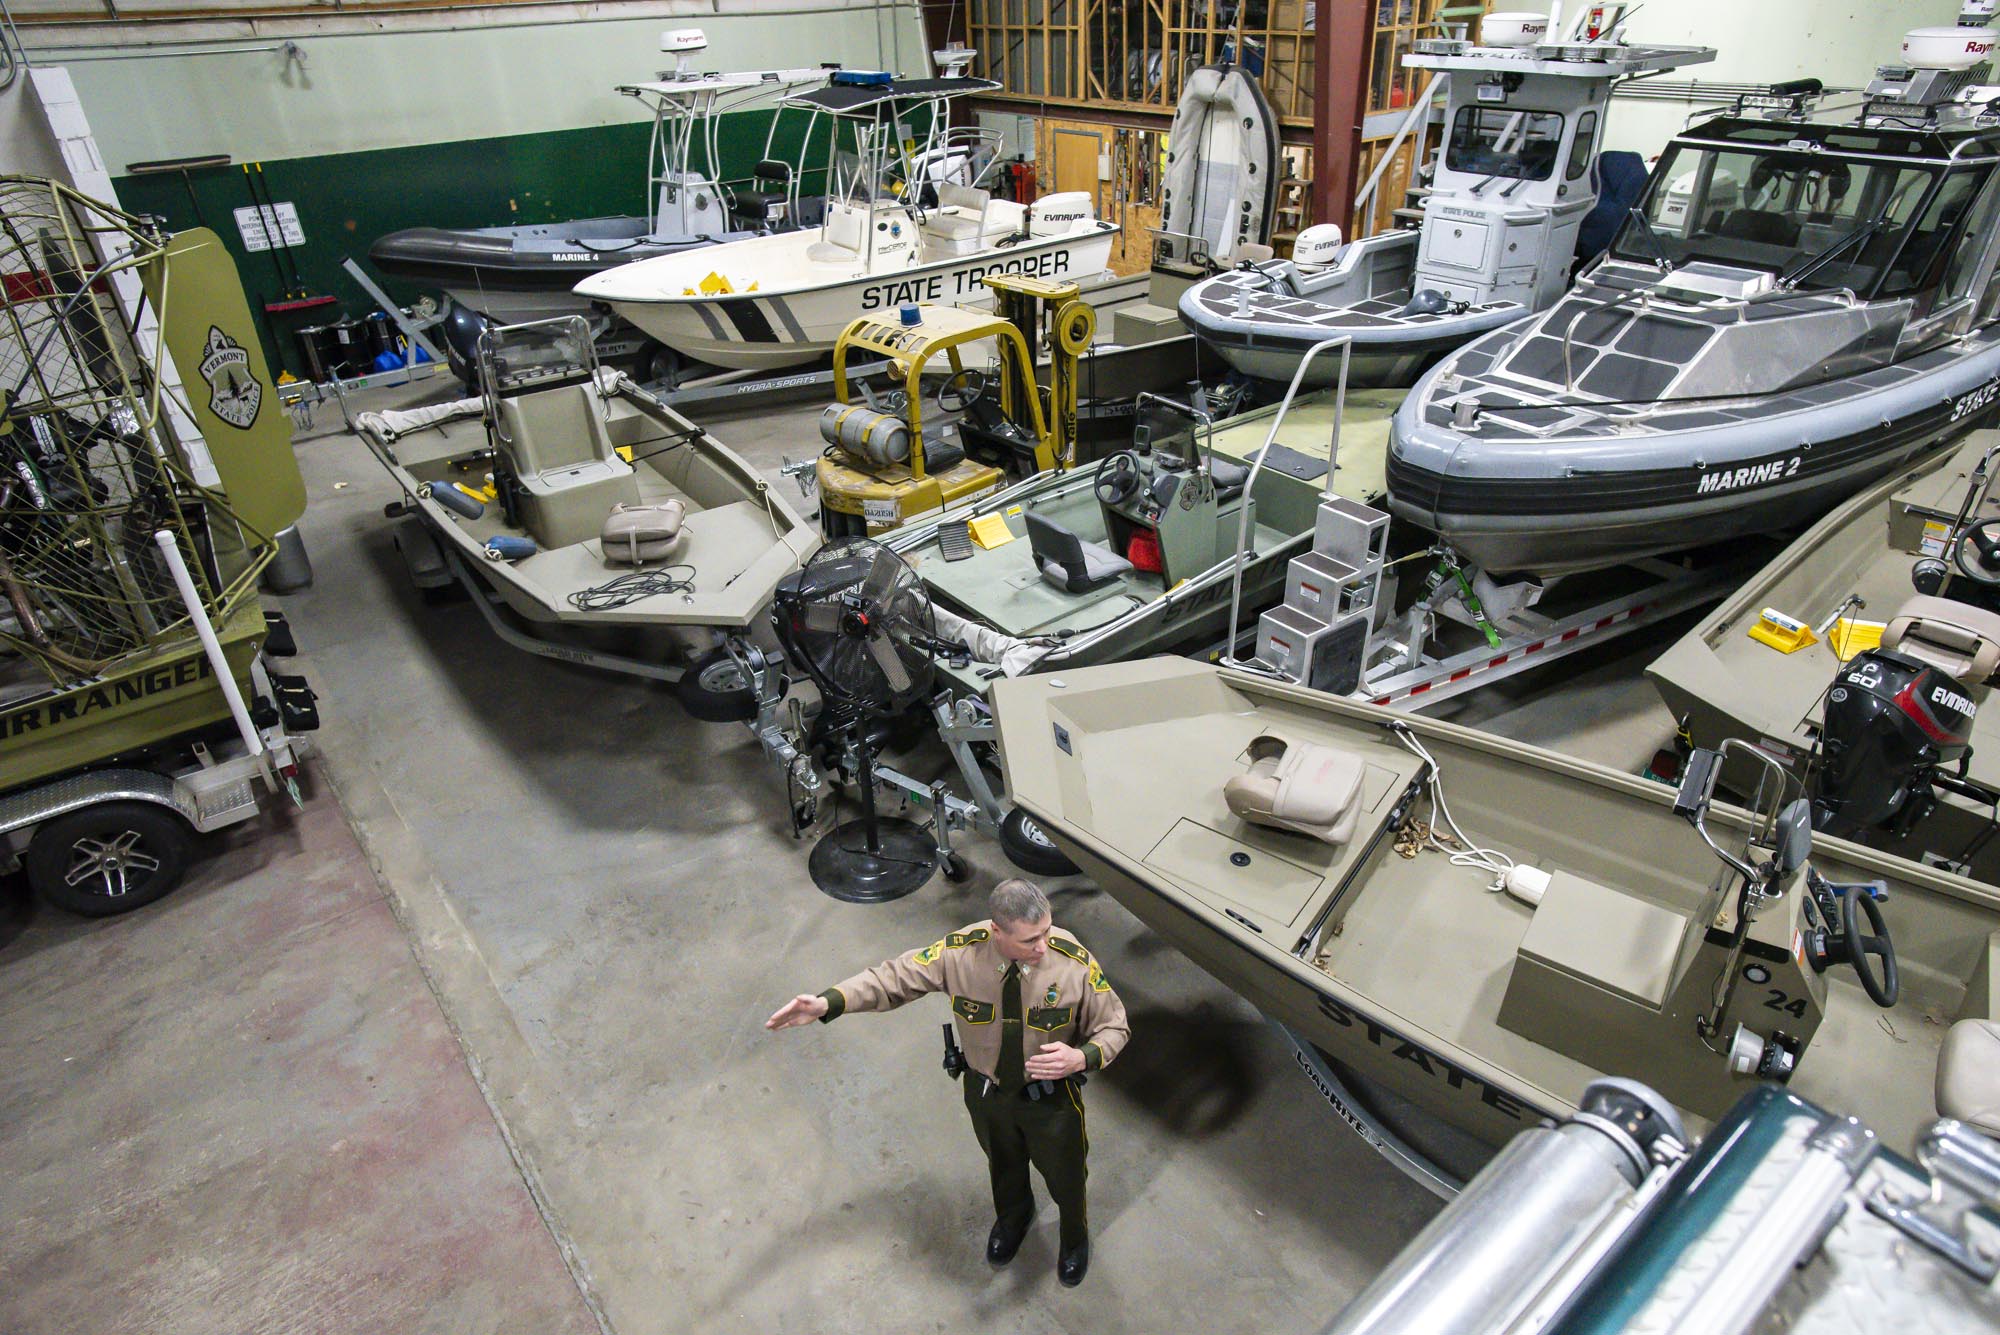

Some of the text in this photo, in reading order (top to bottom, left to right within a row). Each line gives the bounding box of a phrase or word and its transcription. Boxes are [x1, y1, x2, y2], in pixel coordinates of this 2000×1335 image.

[552, 253, 599, 262] MARINE 4
[861, 274, 943, 310] STATE
[204, 352, 245, 374] VERMONT
[213, 385, 260, 423] STATE POLICE
[1697, 456, 1801, 493] MARINE 2
[1847, 672, 1878, 689] 60
[0, 707, 42, 739] IR
[1763, 989, 1808, 1019] 24
[1317, 992, 1521, 1121] STATE
